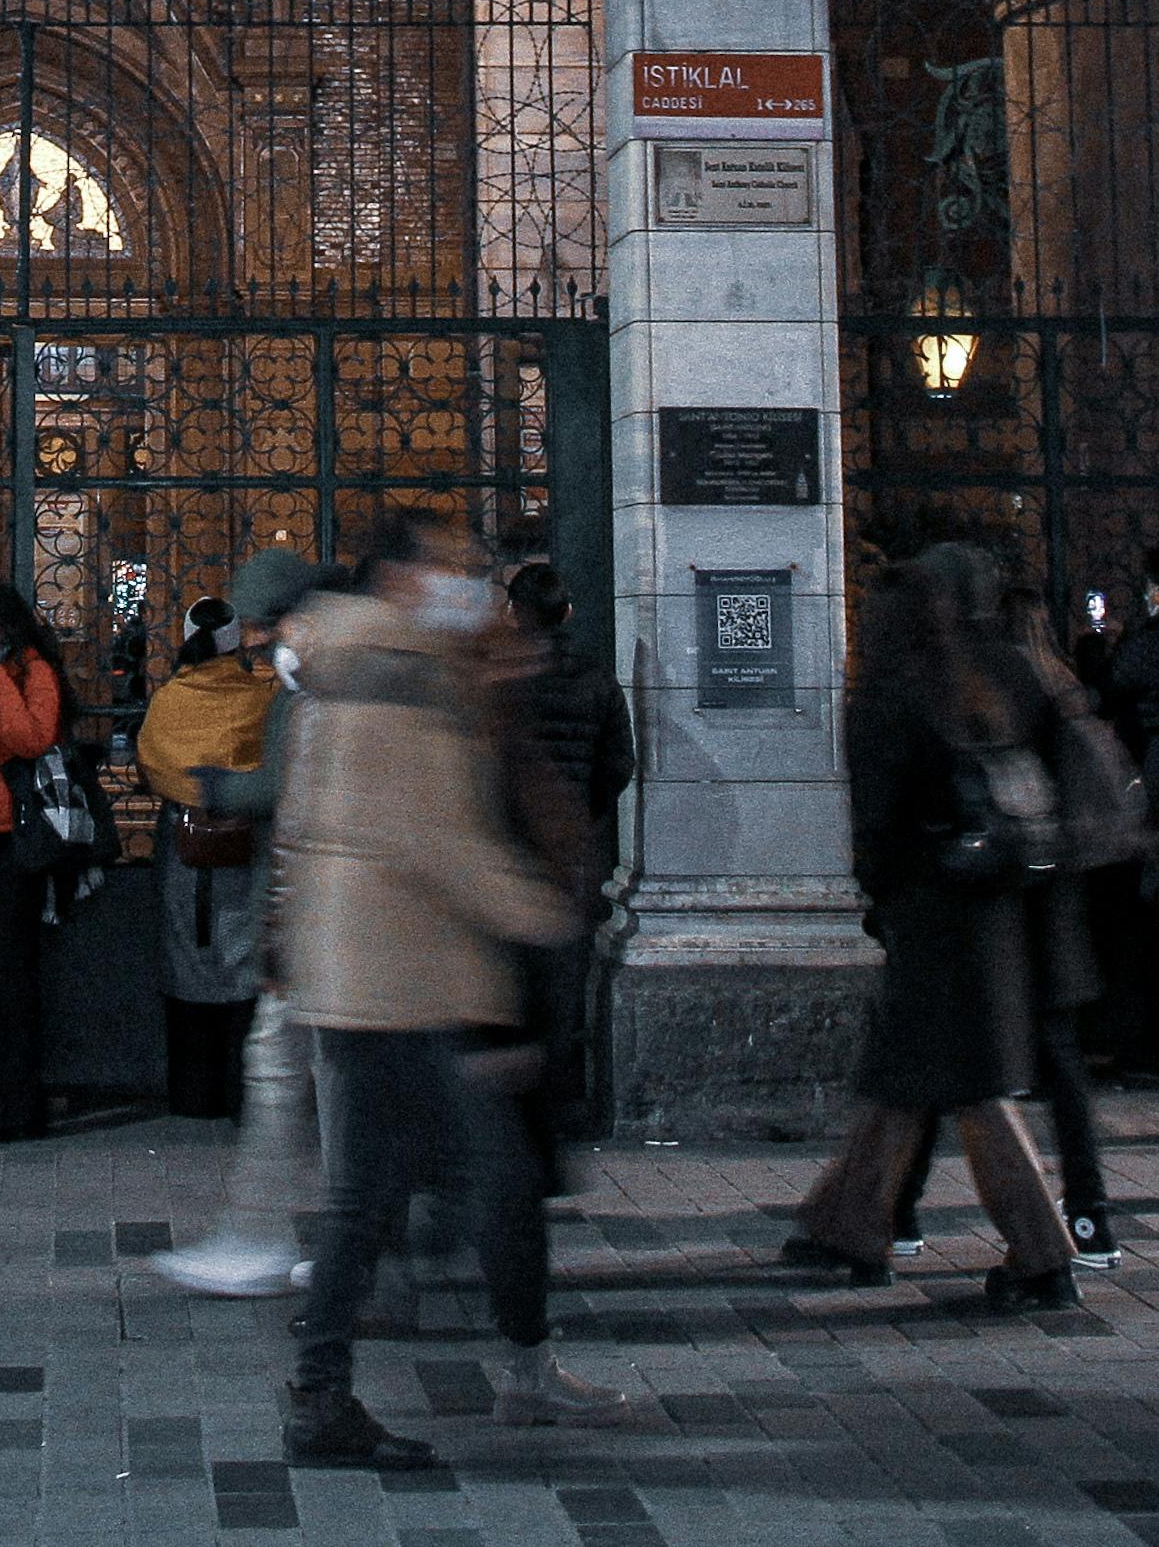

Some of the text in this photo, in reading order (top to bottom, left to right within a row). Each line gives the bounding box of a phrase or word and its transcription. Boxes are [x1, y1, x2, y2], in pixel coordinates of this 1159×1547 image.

[642, 62, 749, 90] İSTİKLAL
[642, 96, 703, 110] CADDESİ
[792, 99, 817, 111] 265
